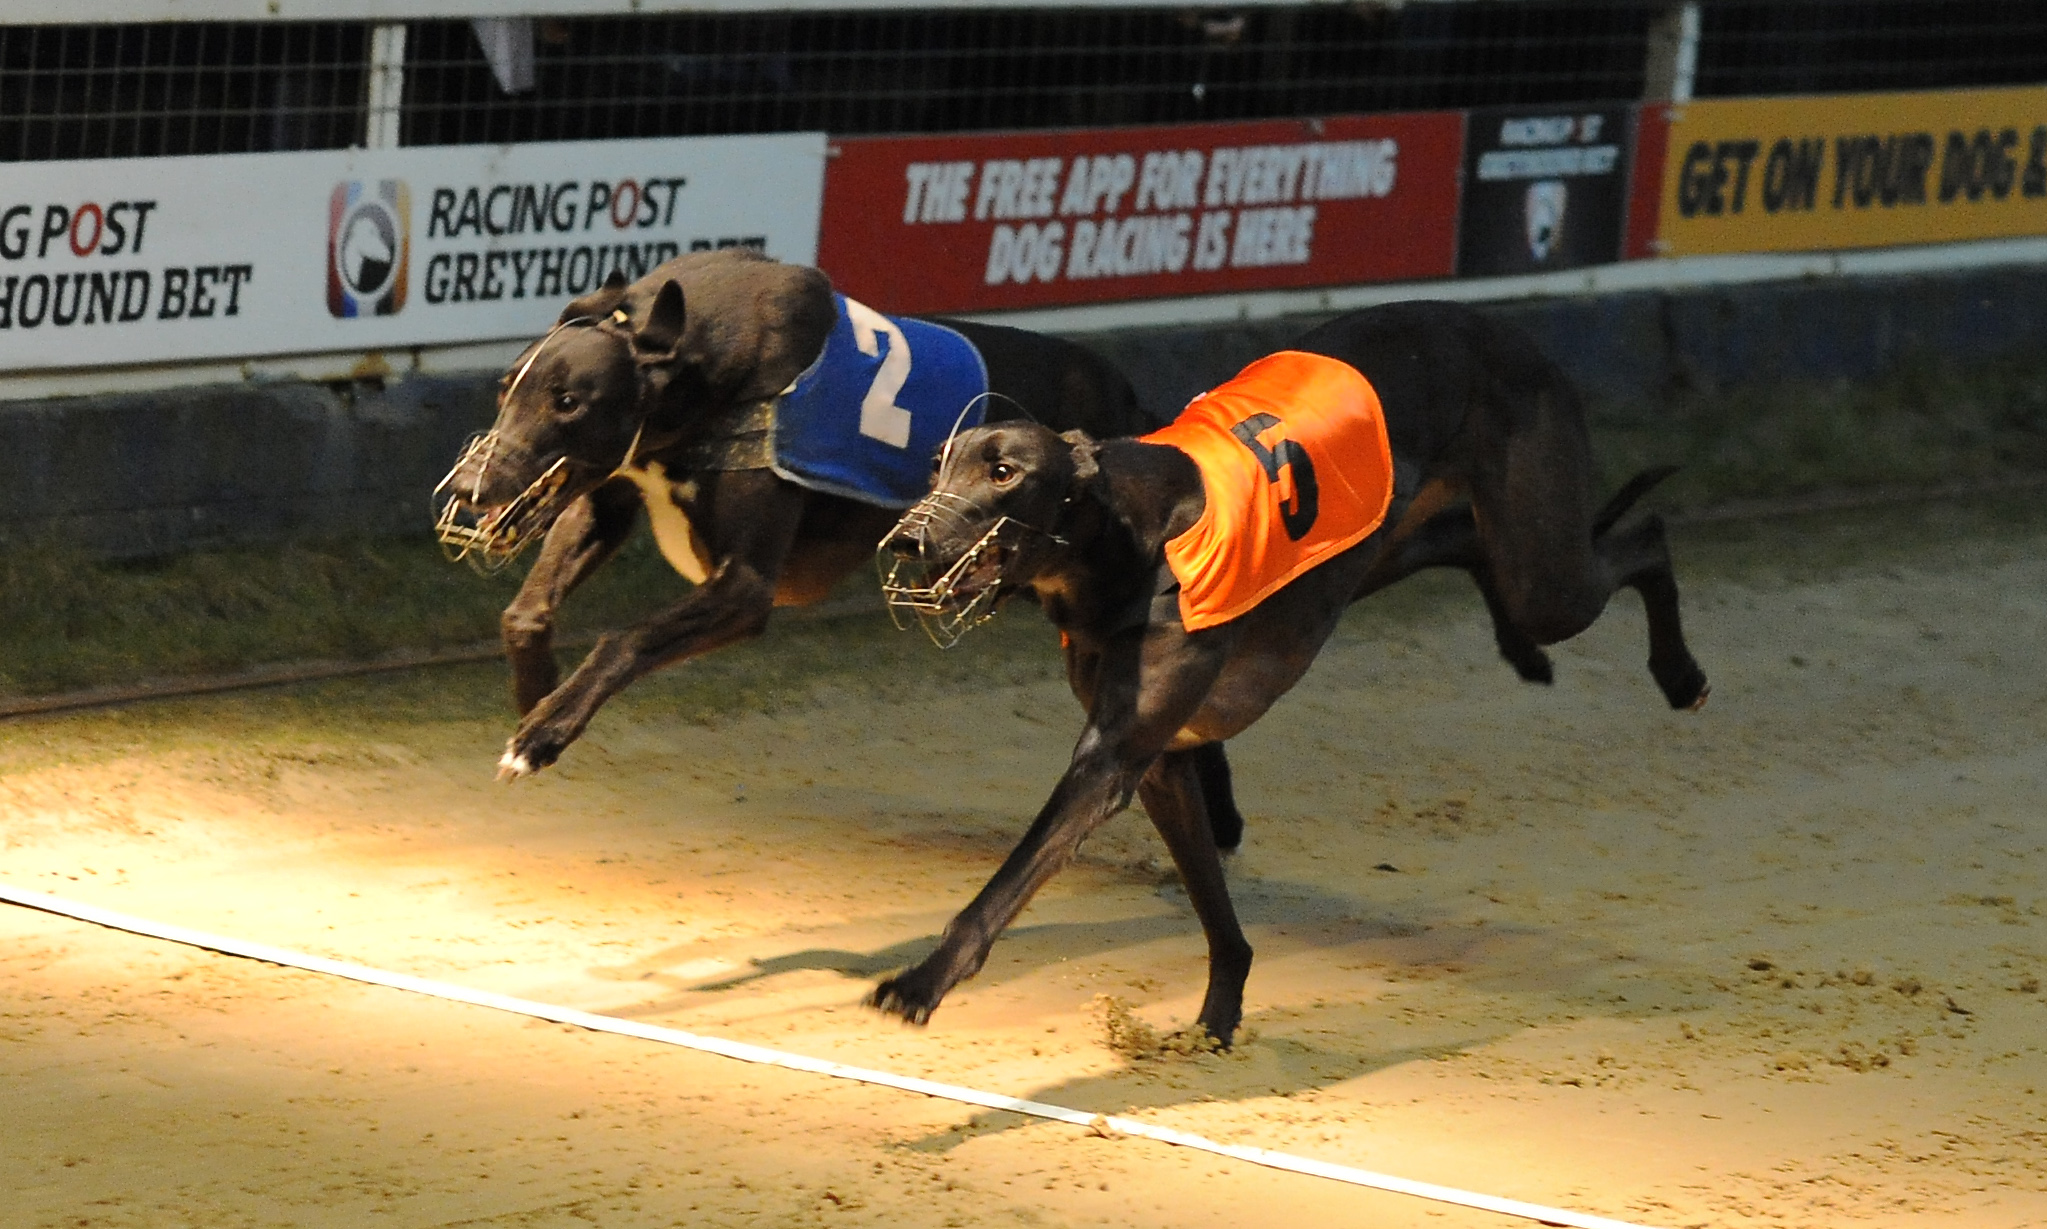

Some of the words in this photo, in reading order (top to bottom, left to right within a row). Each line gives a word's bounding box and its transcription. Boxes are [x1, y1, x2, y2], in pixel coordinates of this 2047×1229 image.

[428, 181, 580, 239] RACING
[584, 178, 687, 231] POST
[903, 162, 976, 225] THE
[974, 157, 1063, 221] FREE
[1059, 155, 1136, 215] APP
[1135, 149, 1204, 211] FOR
[1204, 138, 1397, 206] EVERYTHING
[1678, 139, 1760, 219] GET
[1763, 136, 1826, 215] ON
[1832, 131, 1935, 209] YOUR
[1938, 127, 2019, 205] DOG
[37, 200, 157, 258] POST
[984, 219, 1066, 285] DOG
[1066, 213, 1192, 279] RACING
[1193, 210, 1231, 271] IS
[1231, 205, 1317, 267] HERE
[156, 264, 254, 321] BET
[844, 296, 912, 450] 2
[1229, 411, 1319, 542] 5
